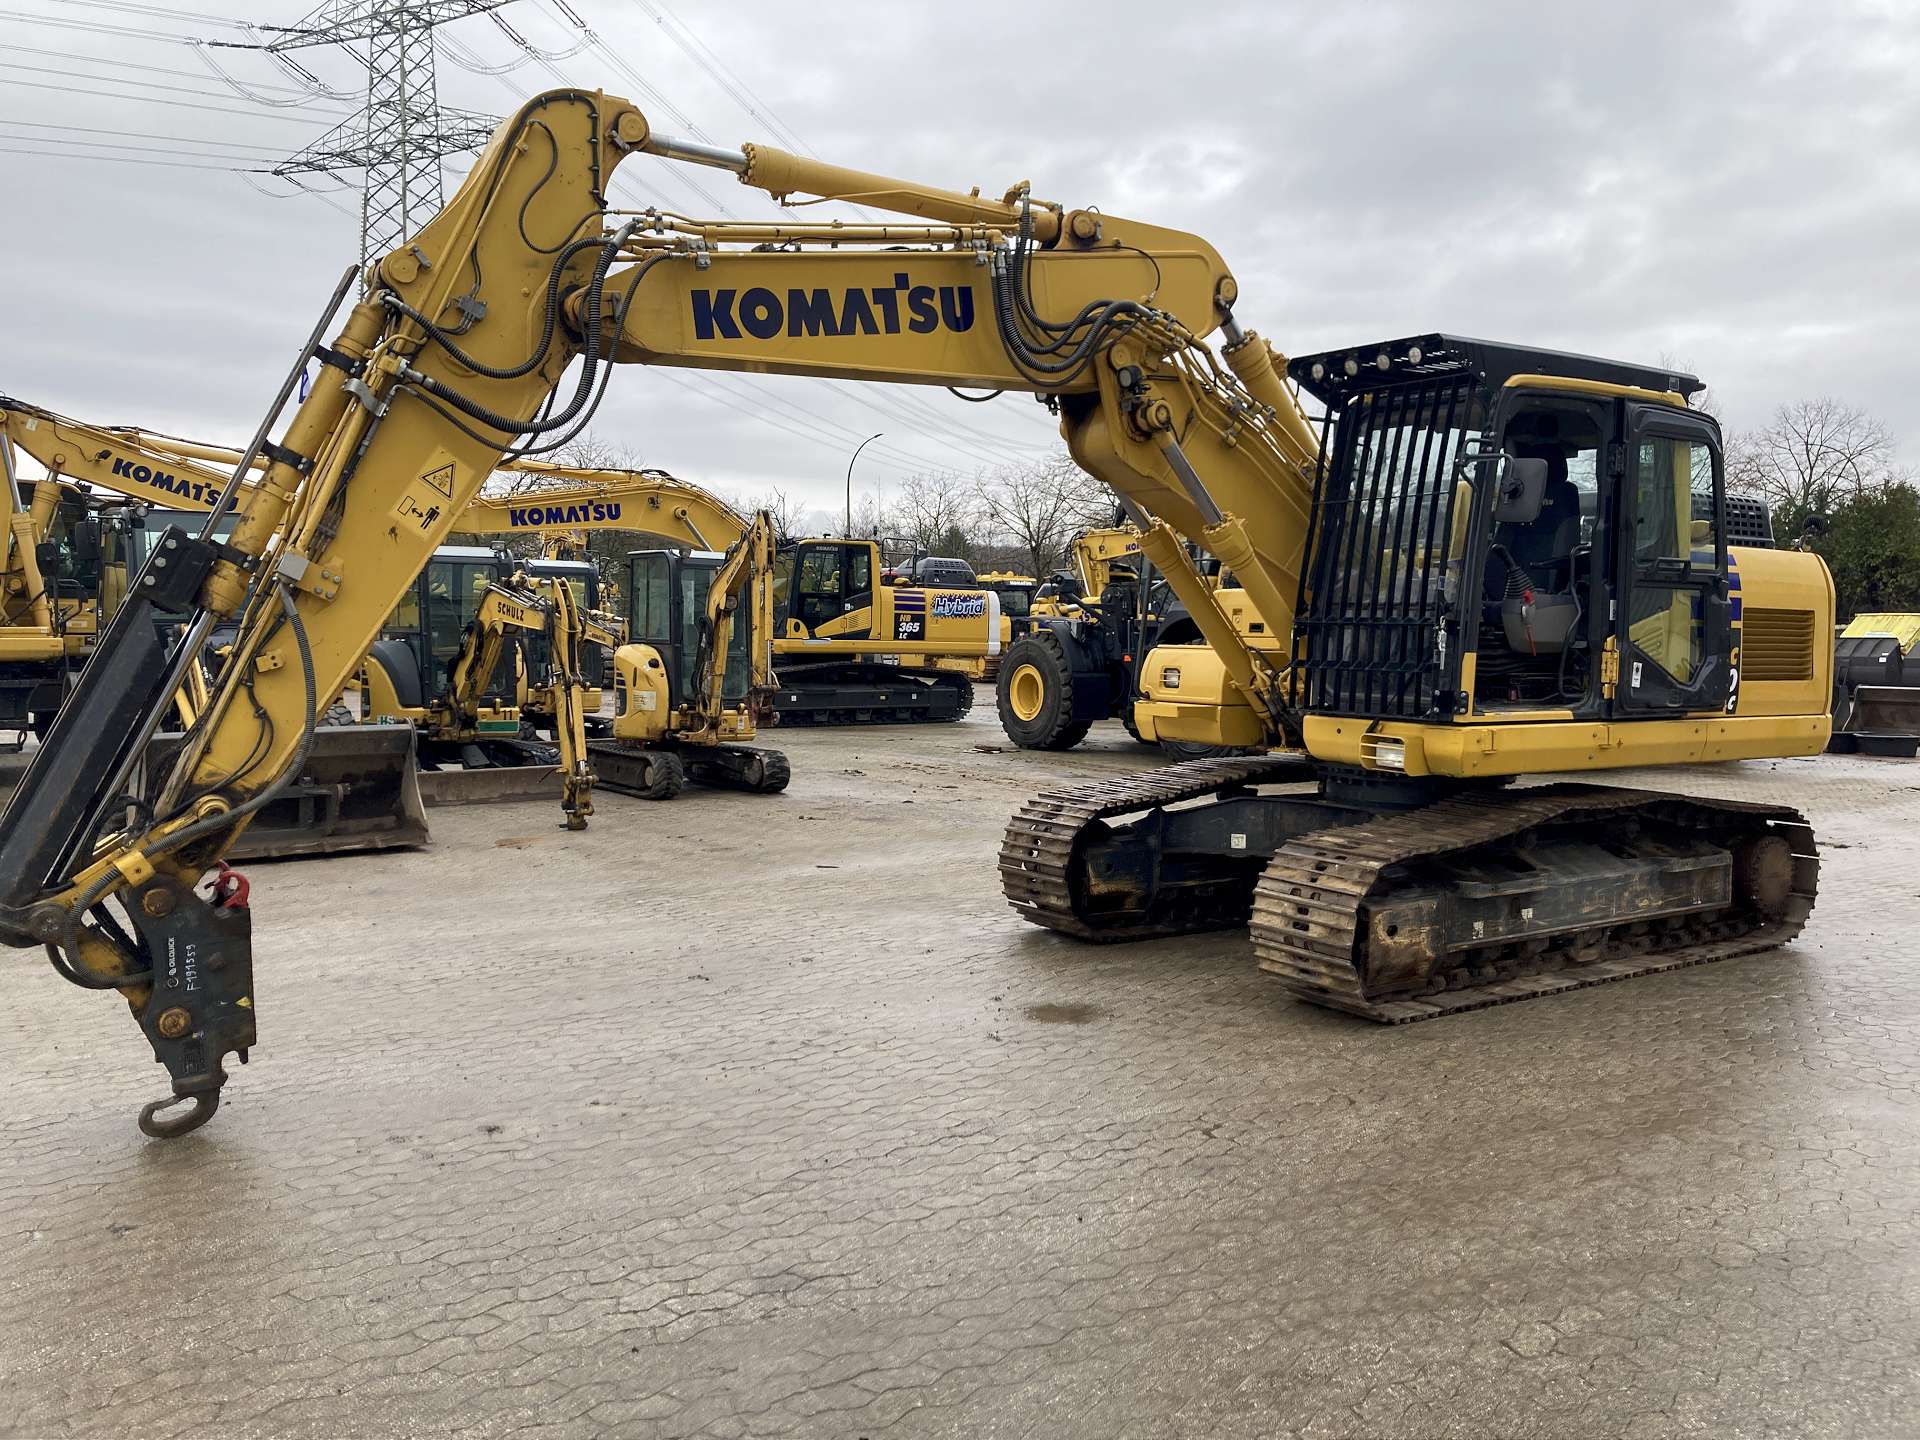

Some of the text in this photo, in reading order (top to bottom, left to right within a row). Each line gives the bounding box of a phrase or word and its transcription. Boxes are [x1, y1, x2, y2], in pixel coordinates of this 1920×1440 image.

[690, 272, 976, 340] KOMATSU
[510, 499, 621, 527] KOMATSU
[497, 601, 525, 622] SCHULZ
[934, 597, 984, 616] Hybrid
[898, 622, 920, 632] 365
[899, 614, 912, 622] HB
[502, 709, 513, 721] 11
